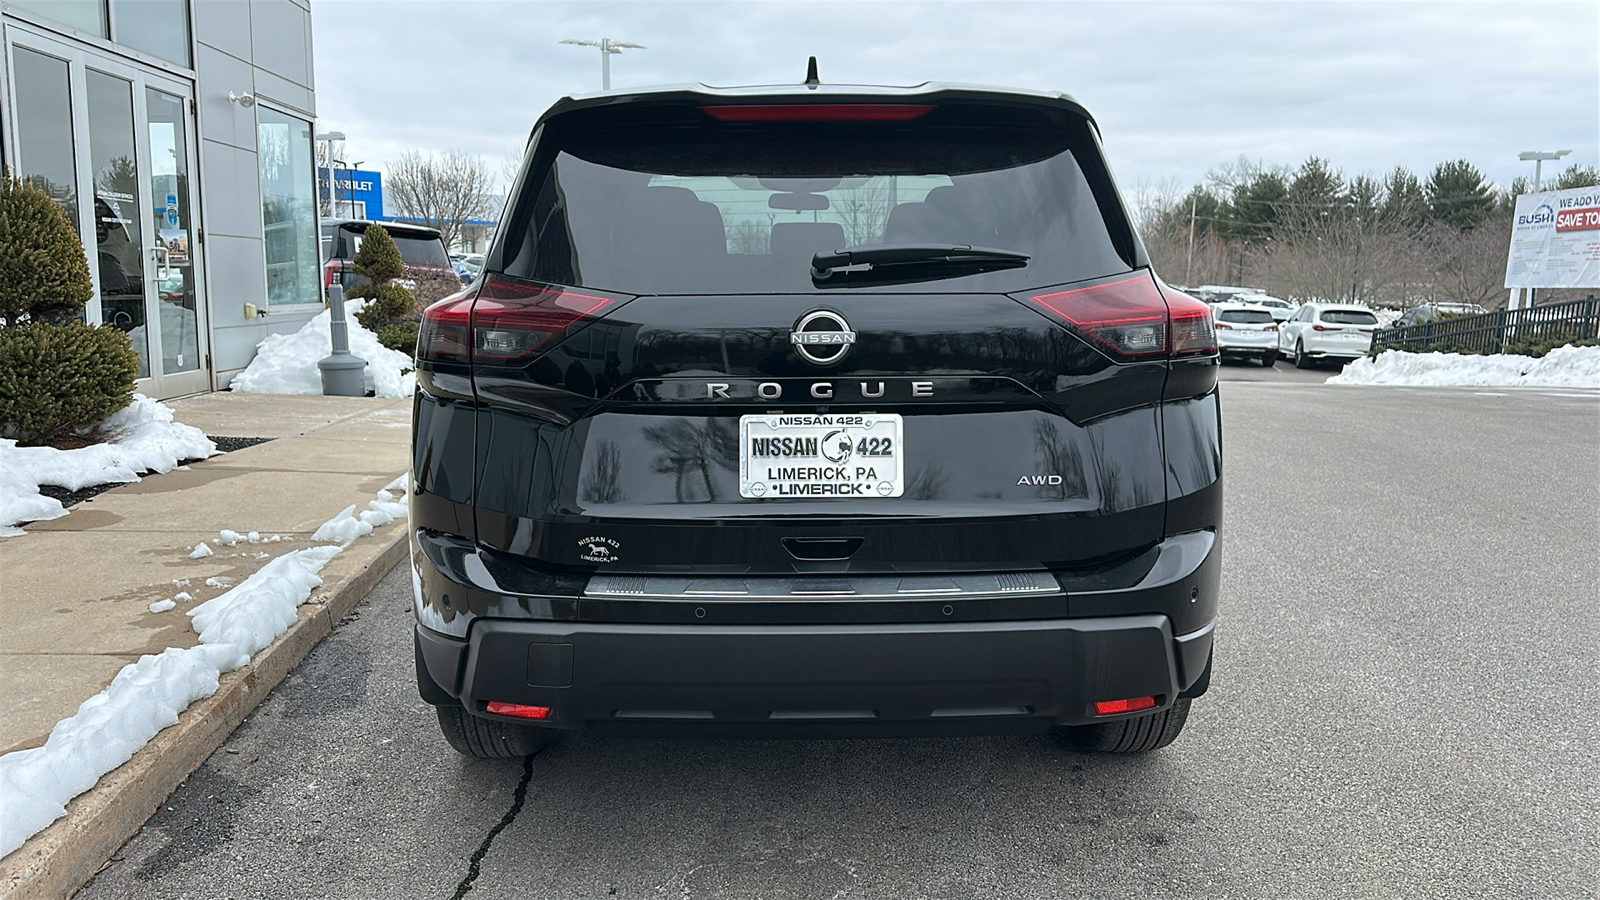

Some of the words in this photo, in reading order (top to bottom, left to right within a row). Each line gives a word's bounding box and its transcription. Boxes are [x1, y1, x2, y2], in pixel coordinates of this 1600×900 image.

[1560, 198, 1573, 208] WE
[1573, 196, 1592, 207] ADD
[1518, 213, 1550, 225] BUSH
[1557, 213, 1583, 228] SAVE
[1585, 211, 1600, 226] TO
[792, 334, 855, 343] NISSAN
[706, 382, 934, 399] ROGUE
[779, 417, 833, 426] NISSAN
[836, 417, 864, 426] 422
[751, 437, 818, 457] NISSAN
[856, 437, 893, 457] 422
[767, 467, 850, 481] LIMERICK,
[856, 467, 878, 480] PA
[1016, 475, 1062, 485] AWD
[779, 483, 864, 495] LIMERICK
[578, 536, 606, 546] NISSAN
[607, 538, 620, 548] 422
[580, 554, 610, 563] LIMERICK,
